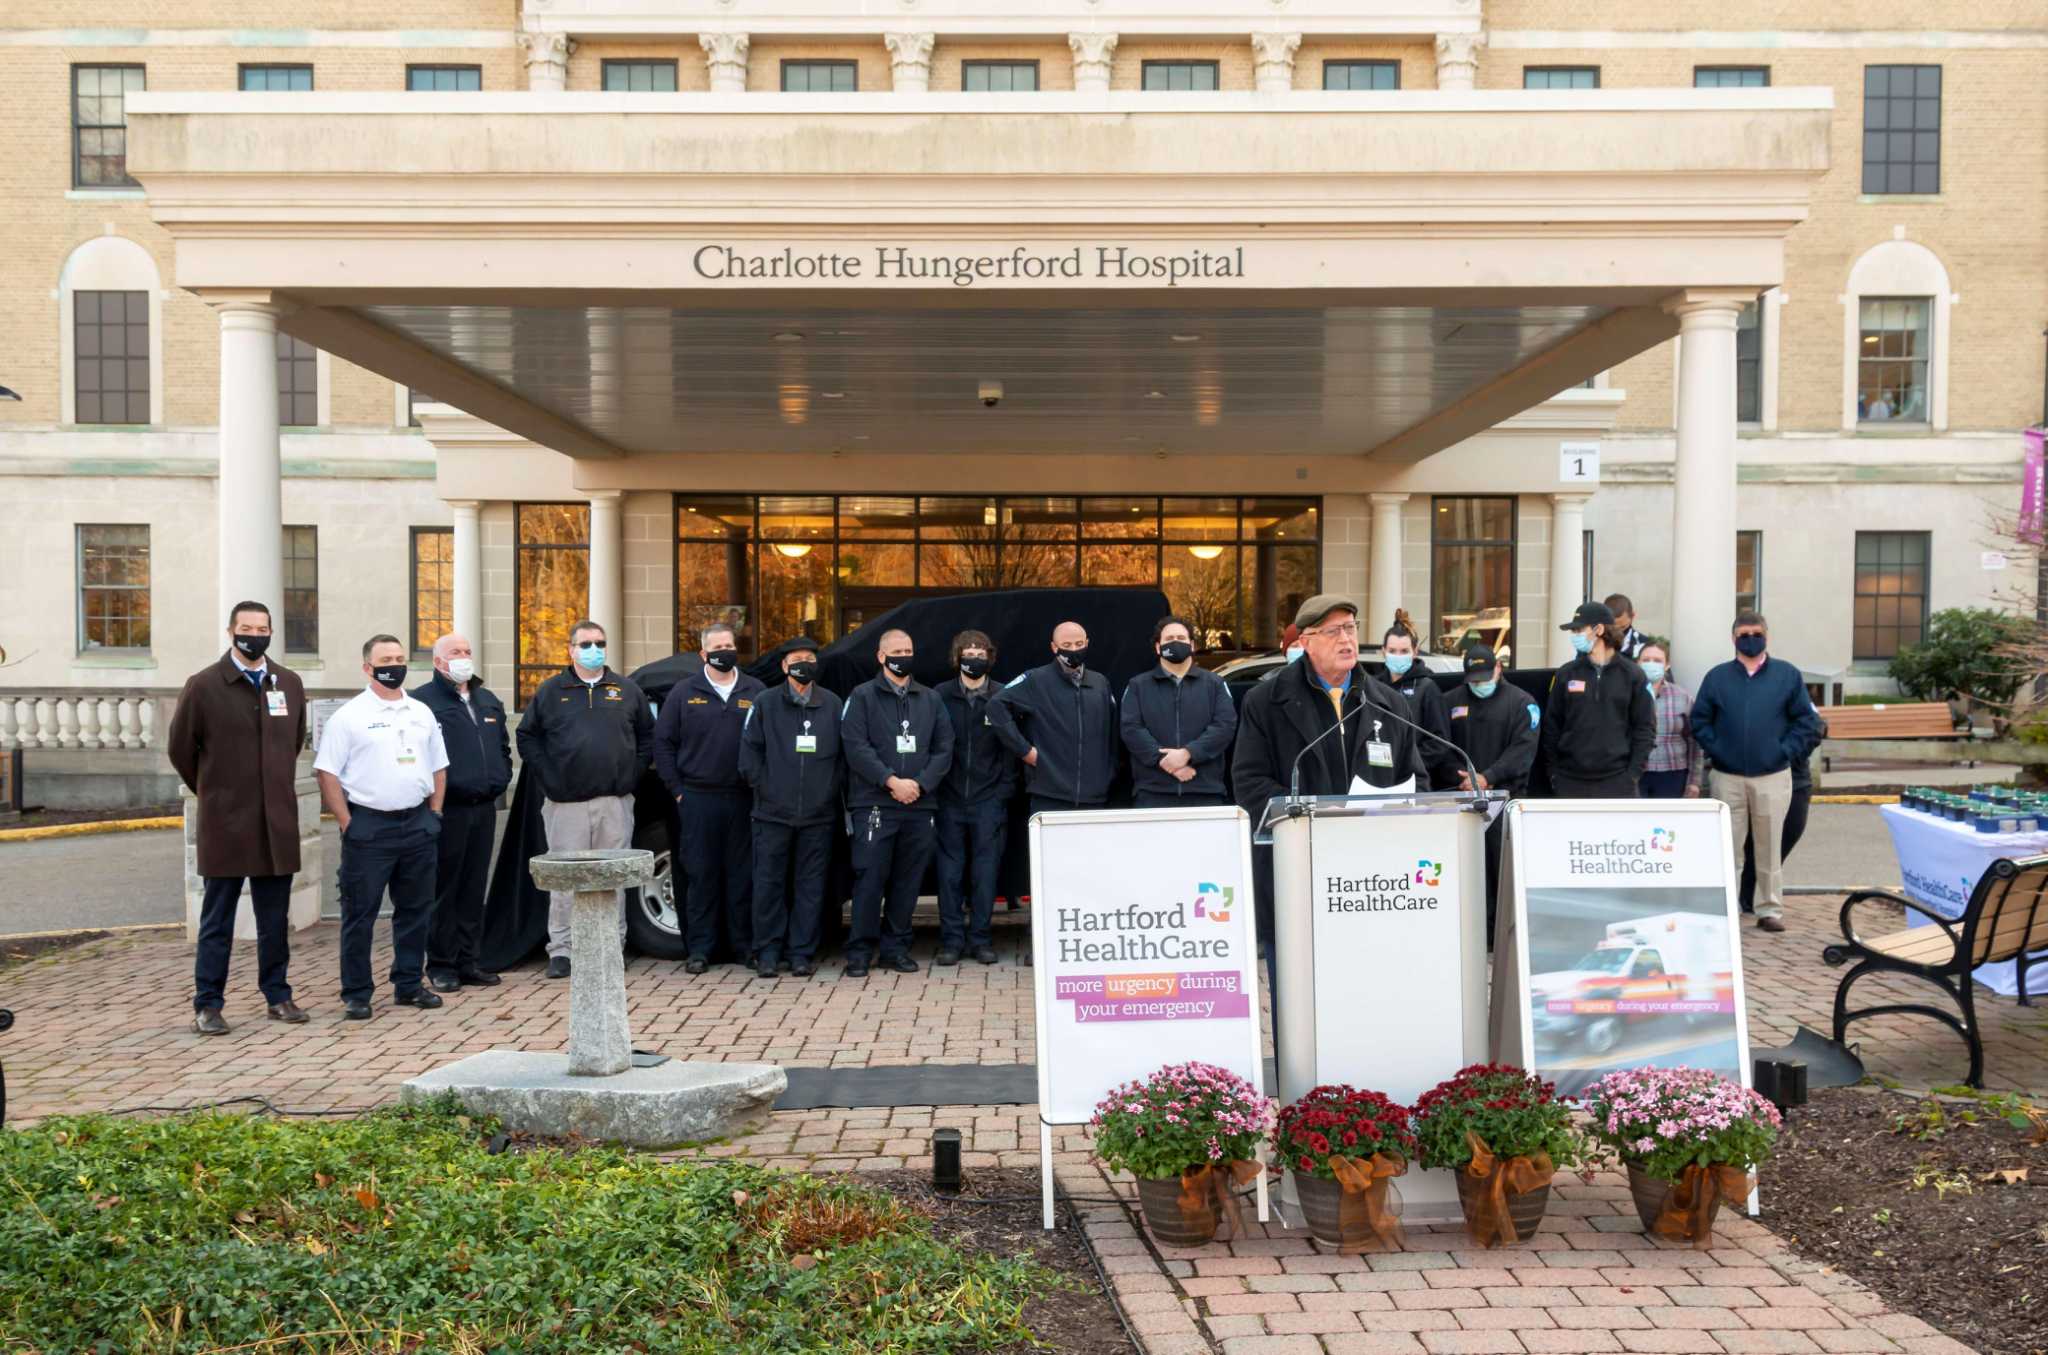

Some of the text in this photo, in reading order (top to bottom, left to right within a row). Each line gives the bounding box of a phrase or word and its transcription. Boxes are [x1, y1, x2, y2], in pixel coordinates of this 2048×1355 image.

[693, 245, 1245, 286] Charlotte Hungerford Hospital
[1574, 458, 1586, 476] 1
[1568, 838, 1647, 856] Hartford
[1570, 857, 1673, 875] HealthCare
[1326, 873, 1411, 893] Hartford
[1327, 894, 1438, 913] HealthCare
[1057, 902, 1187, 932] Hartford
[1058, 934, 1230, 963] HealthCare
[1058, 973, 1237, 995] more urgency during
[1079, 1000, 1215, 1022] your emergency
[1616, 1000, 1648, 1013] during
[1648, 1002, 1671, 1013] your
[1670, 1000, 1720, 1013] emergency
